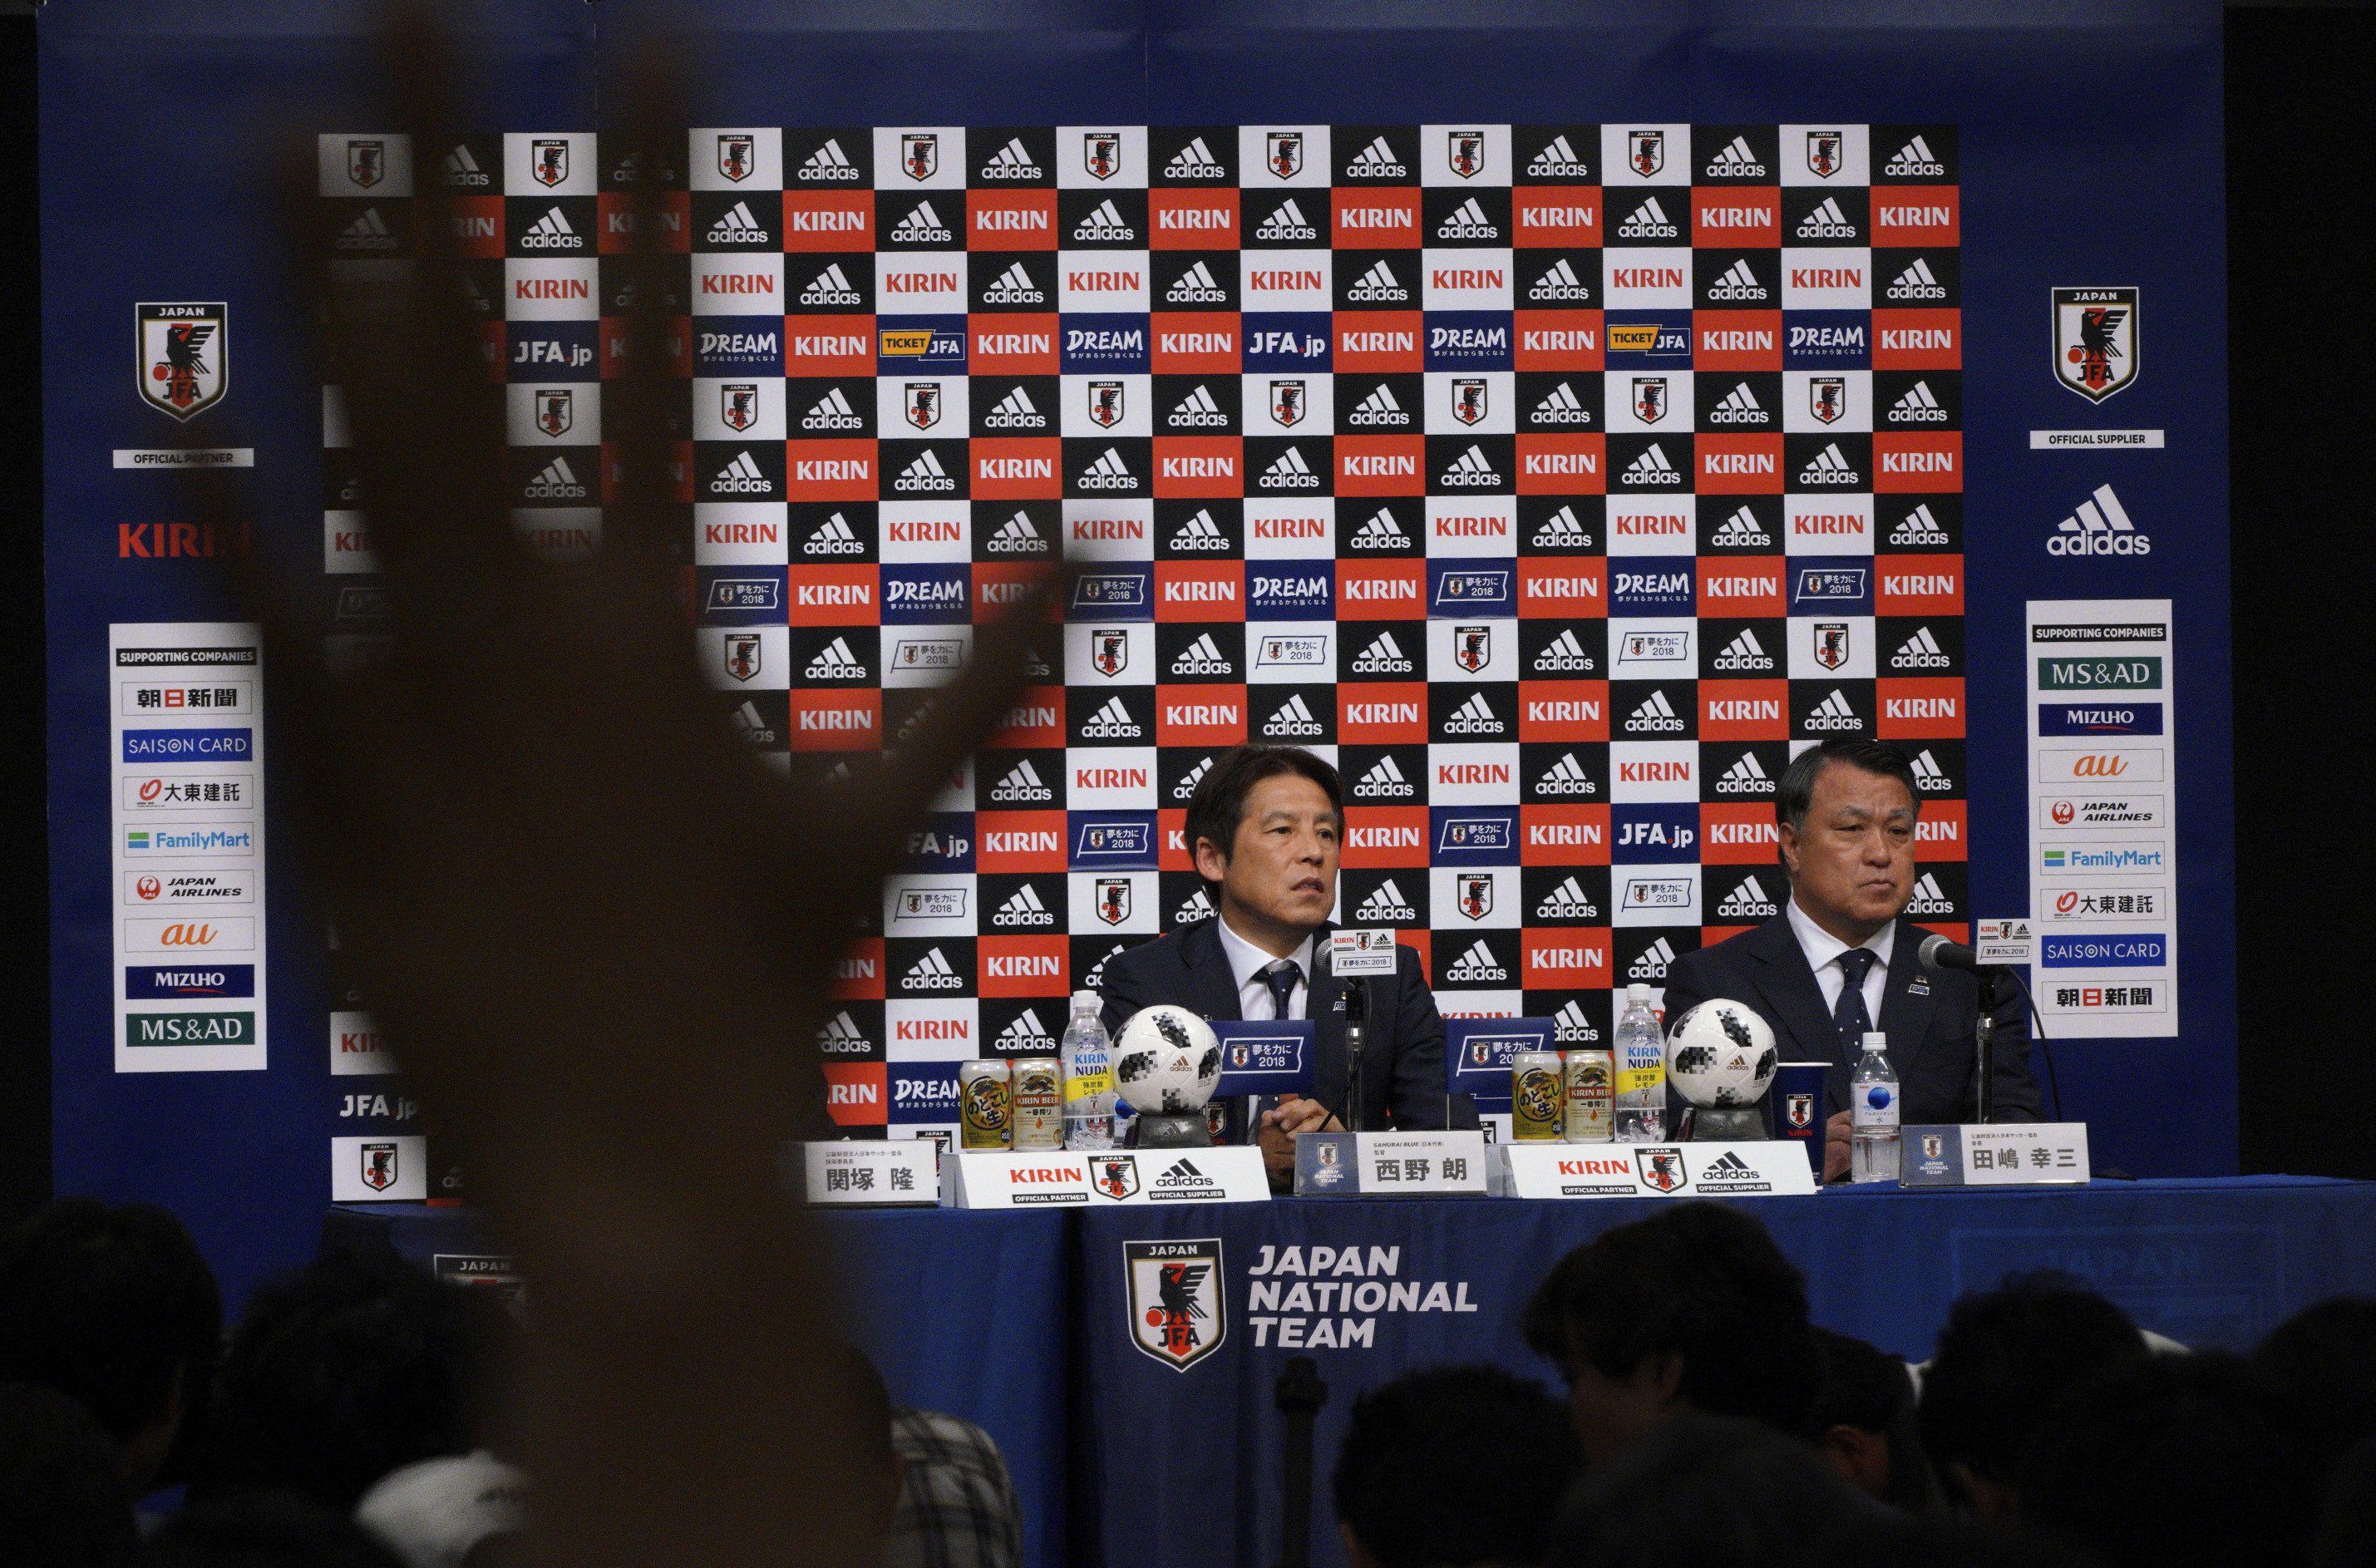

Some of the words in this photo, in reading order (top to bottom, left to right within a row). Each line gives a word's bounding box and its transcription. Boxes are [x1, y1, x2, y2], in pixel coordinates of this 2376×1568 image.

[798, 165, 859, 181] adidas
[1886, 163, 1944, 178] adidas
[793, 210, 865, 231] KIRIN
[1881, 206, 1950, 227] KIRIN
[521, 233, 583, 248] adidas
[515, 278, 589, 298] KIRIN
[2073, 292, 2117, 301] JAPAN
[158, 307, 205, 317] JAPAN
[700, 332, 777, 354] DREAM
[885, 337, 927, 349] TICKET
[929, 339, 960, 353] JFA
[1067, 329, 1144, 351] DREAM
[1250, 332, 1327, 356] JFA.jp
[1612, 333, 1653, 345] TICKET
[1656, 335, 1685, 349] JFA
[1791, 326, 1865, 348] DREAM
[514, 341, 592, 366] JFA.jp
[2077, 365, 2115, 382] JFA
[162, 382, 203, 399] JFA
[986, 413, 1046, 429] adidas
[2048, 435, 2096, 445] OFFICIAL
[2097, 434, 2146, 444] SUPPLIER
[134, 454, 181, 464] OFFICIAL
[119, 522, 250, 558] KIRI
[706, 523, 778, 544] KIRIN
[2046, 530, 2151, 556] adidas
[1254, 576, 1329, 598] DREAM
[1825, 574, 1857, 584] 夢を力に
[1166, 580, 1236, 601] KIRIN
[1830, 584, 1853, 594] 2018
[2036, 629, 2102, 639] SUPPORTING
[2103, 628, 2164, 638] COMPANIES
[1647, 637, 1679, 647] 夢を力に
[120, 652, 190, 663] SUPPORTING
[190, 651, 254, 662] COMPANIES
[1652, 648, 1675, 657] 2018
[2052, 663, 2150, 684] MS&AD
[137, 688, 237, 708] 朝日新聞
[1887, 698, 1956, 718] KIRIN
[1082, 723, 1142, 739] adidas
[129, 738, 194, 754] SAISON
[199, 737, 247, 752] CARD
[1440, 763, 1511, 784] KIRIN
[2073, 755, 2129, 777] au
[165, 783, 240, 802] 大東建託
[2081, 802, 2128, 811] JAPAN
[2083, 813, 2152, 821] AIRLINES
[156, 831, 249, 850] FamilyMart
[1107, 829, 1141, 838] 夢を力に
[1619, 823, 1694, 847] JFA.jp
[1112, 839, 1136, 848] 2018
[2071, 851, 2162, 868] FamilyMart
[167, 877, 216, 886] JAPAN
[170, 888, 242, 897] AIRLINES
[924, 893, 959, 903] 夢を力に
[930, 903, 954, 913] 2018
[2080, 895, 2153, 914] 大東建託
[993, 911, 1053, 926] adidas
[1357, 906, 1417, 921] adidas
[160, 923, 219, 945] au
[1533, 948, 1603, 969] KIRIN
[2047, 944, 2110, 959] SAISON
[2114, 943, 2161, 958] CARD
[2056, 988, 2152, 1007] 朝日新聞
[141, 1018, 242, 1041] MS&AD
[995, 1036, 1055, 1051] adidas
[1252, 1043, 1292, 1056] 夢を力に
[1492, 1042, 1532, 1053] 夢を力に
[1074, 1053, 1108, 1064] KIRIN
[1628, 1047, 1660, 1057] KIRIN
[1259, 1057, 1285, 1068] 2018
[1628, 1058, 1660, 1069] NUDA
[1075, 1066, 1108, 1076] NUDA
[1634, 1073, 1656, 1082] 強炭酸
[1973, 1148, 2019, 1170] 田嶋
[2030, 1147, 2077, 1169] 幸三
[1010, 1167, 1082, 1183] KIRIN
[1374, 1158, 1430, 1182] 西野
[1442, 1157, 1467, 1181] 朗
[1558, 1160, 1629, 1175] KIRIN
[1702, 1168, 1760, 1180] adidas
[826, 1167, 875, 1191] 関塚
[890, 1166, 914, 1191] 隆
[1156, 1176, 1214, 1187] adidas
[1107, 1185, 1128, 1194] JFA
[1151, 1191, 1186, 1200] OFFICIAL
[1186, 1191, 1224, 1199] SUPPLIER
[1148, 1244, 1199, 1257] JAPAN
[1248, 1245, 1401, 1277] JAPAN
[1248, 1281, 1478, 1313] NATIONAL
[1157, 1326, 1202, 1349] JFA
[1249, 1316, 1377, 1349] TEAM
